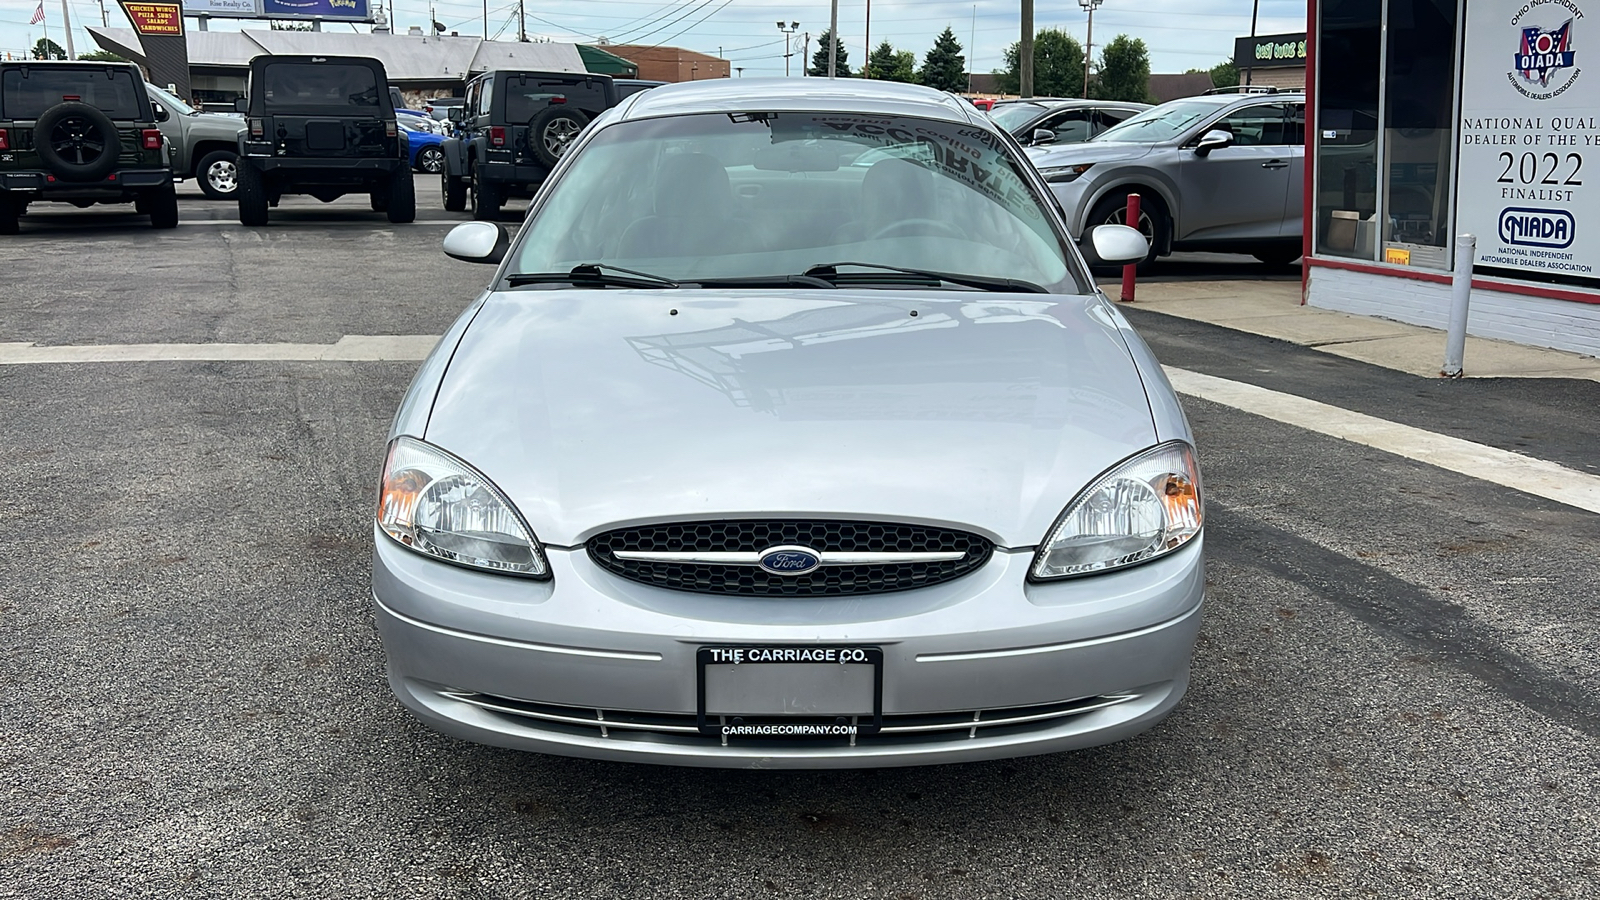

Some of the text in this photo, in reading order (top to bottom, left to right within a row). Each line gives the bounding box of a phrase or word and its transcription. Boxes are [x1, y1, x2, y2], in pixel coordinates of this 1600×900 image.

[223, 0, 241, 9] Realty
[1511, 0, 1584, 26] OHIO INDNDENT
[1521, 53, 1564, 69] OIADA
[1507, 72, 1530, 98] AUTOMOBILE
[1553, 68, 1581, 98] ASSOCIATION
[1463, 117, 1600, 132] NATIONAL QUAL
[1464, 134, 1517, 145] DEALER
[1523, 135, 1542, 145] OF
[1548, 135, 1577, 146] THE
[1497, 151, 1583, 186] 2022
[1502, 188, 1574, 202] FINALIST
[1505, 216, 1567, 240] NIADA
[1498, 247, 1573, 261] NATIONAL INDEPENDENT
[1481, 255, 1592, 273] AUTOMOBILE DEALERS ASSOCIATION
[772, 553, 806, 568] Ford
[710, 649, 869, 662] THE CARRIAGE CO.
[721, 725, 858, 735] CARRIAGECOMPANY.COM
